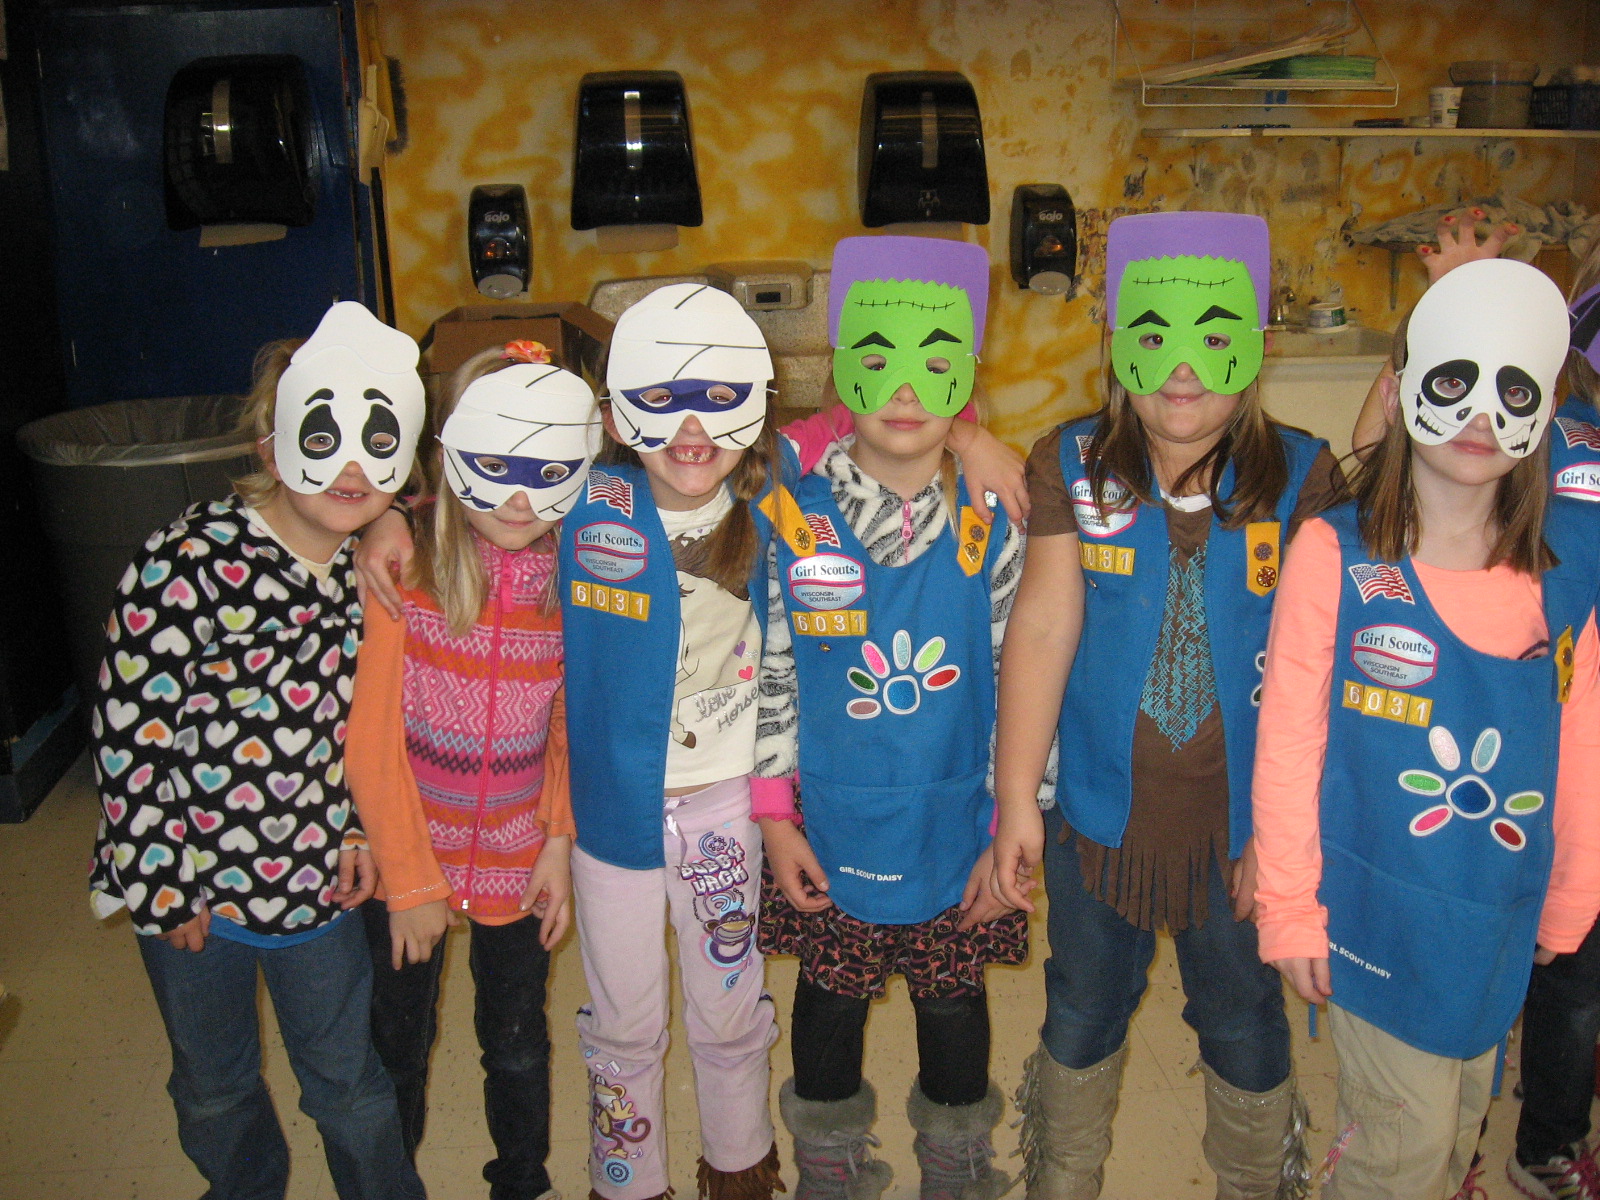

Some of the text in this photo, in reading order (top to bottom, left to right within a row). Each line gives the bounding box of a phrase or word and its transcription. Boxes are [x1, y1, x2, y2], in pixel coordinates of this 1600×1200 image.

[1561, 471, 1585, 485] Girl
[581, 530, 640, 547] Girl Scouts
[585, 557, 617, 567] WISCONSIN
[1087, 547, 1130, 571] 031
[592, 564, 624, 574] SOUTHEAST
[795, 564, 856, 577] Girl Scouts
[576, 585, 643, 616] 6031
[797, 614, 863, 632] 6031
[1360, 632, 1429, 654] Girl Scouts
[1363, 660, 1400, 672] WISCONSIN
[1370, 667, 1408, 680] SOUTHEAST
[695, 687, 736, 722] Love
[1349, 686, 1428, 722] 6031
[839, 866, 903, 882] GIRL SCOUT DAISY
[1329, 941, 1392, 979] RL SCOUT DAISY
